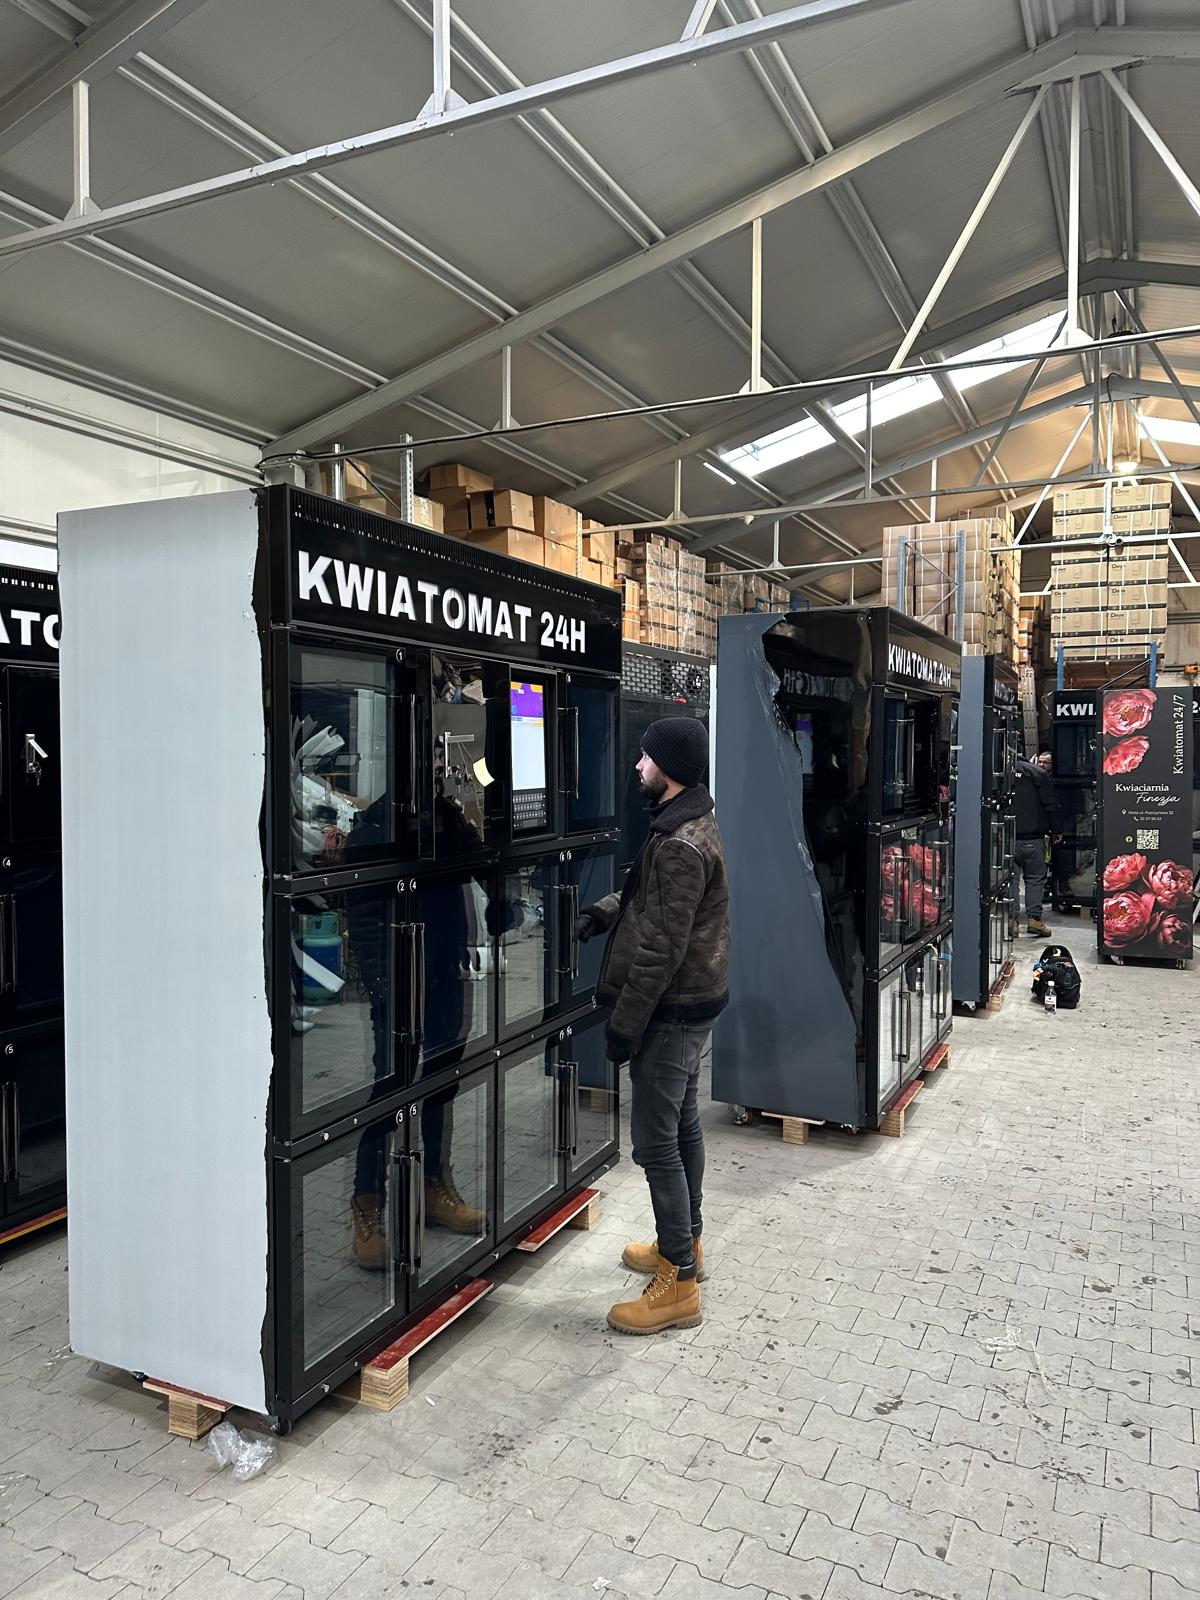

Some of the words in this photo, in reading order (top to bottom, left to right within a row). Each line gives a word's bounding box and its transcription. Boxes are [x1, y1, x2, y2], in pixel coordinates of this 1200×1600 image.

[298, 550, 532, 642] KWIATOMAT
[540, 611, 586, 653] 24H
[888, 643, 937, 683] KWIATOMAT
[939, 663, 952, 688] 24H
[1056, 703, 1097, 716] KWI
[1173, 694, 1186, 719] 24/7
[1173, 720, 1184, 775] Kwiatomat
[1115, 783, 1170, 792] Kwiaciarnia
[1135, 791, 1181, 807] Finezja
